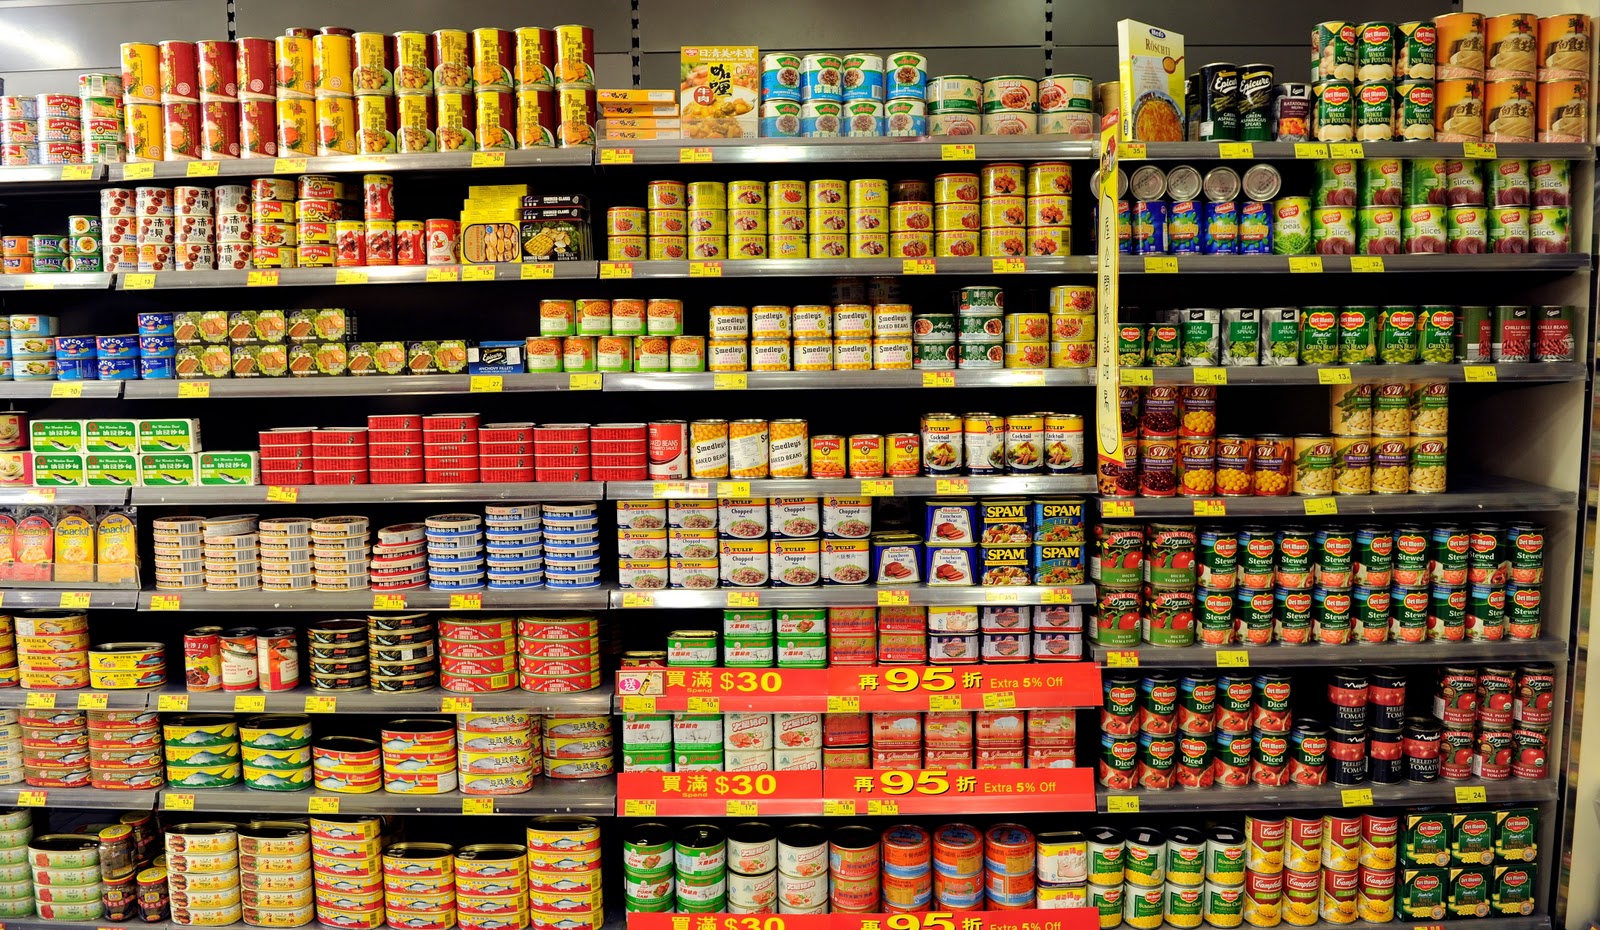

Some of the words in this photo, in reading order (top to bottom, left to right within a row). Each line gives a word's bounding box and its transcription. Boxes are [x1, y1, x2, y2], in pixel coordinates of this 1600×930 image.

[1372, 30, 1390, 38] Monte
[699, 48, 755, 58] 日清美味寶
[735, 66, 756, 77] Curry
[1215, 77, 1237, 89] Epicu
[1240, 77, 1270, 92] Epicure
[697, 87, 709, 103] 牛肉
[1332, 91, 1350, 99] Monte
[1541, 179, 1562, 187] slices
[1332, 228, 1351, 236] slices
[1421, 227, 1441, 235] slices
[718, 316, 745, 325] Smedley's
[754, 312, 783, 322] Smedley's
[793, 312, 821, 321] Smedley's
[837, 312, 866, 321] Smedley's
[878, 315, 908, 323] Smedley's
[715, 346, 744, 356] Smedley's
[696, 442, 727, 454] Smedley's
[695, 457, 710, 465] BAKED
[711, 452, 727, 462] BEANS
[987, 506, 1024, 517] SPAM
[1044, 506, 1081, 517] SPAM
[988, 549, 1025, 560] SPAM
[1042, 548, 1079, 559] SPAM
[1248, 557, 1272, 565] Stewed
[623, 679, 637, 691] 送
[666, 671, 713, 687] 買滿
[720, 672, 782, 692] $30
[859, 675, 879, 690] 再
[885, 668, 956, 692] 95
[962, 672, 982, 688] 折
[991, 678, 1019, 688] Extra
[1023, 678, 1042, 687] 5%
[1046, 676, 1063, 687] Off
[1154, 703, 1174, 711] Diced
[1267, 700, 1288, 708] Diced
[1115, 759, 1135, 767] Diced
[662, 775, 708, 792] 買滿
[715, 774, 776, 794] $30
[854, 777, 874, 792] 再
[880, 771, 950, 794] 95
[957, 776, 977, 792] 折
[985, 783, 1012, 793] Extra
[1016, 783, 1035, 791] 5%
[1040, 782, 1056, 792] Off
[724, 917, 785, 930] $30
[886, 913, 955, 930] 95
[1045, 922, 1061, 930] Off
